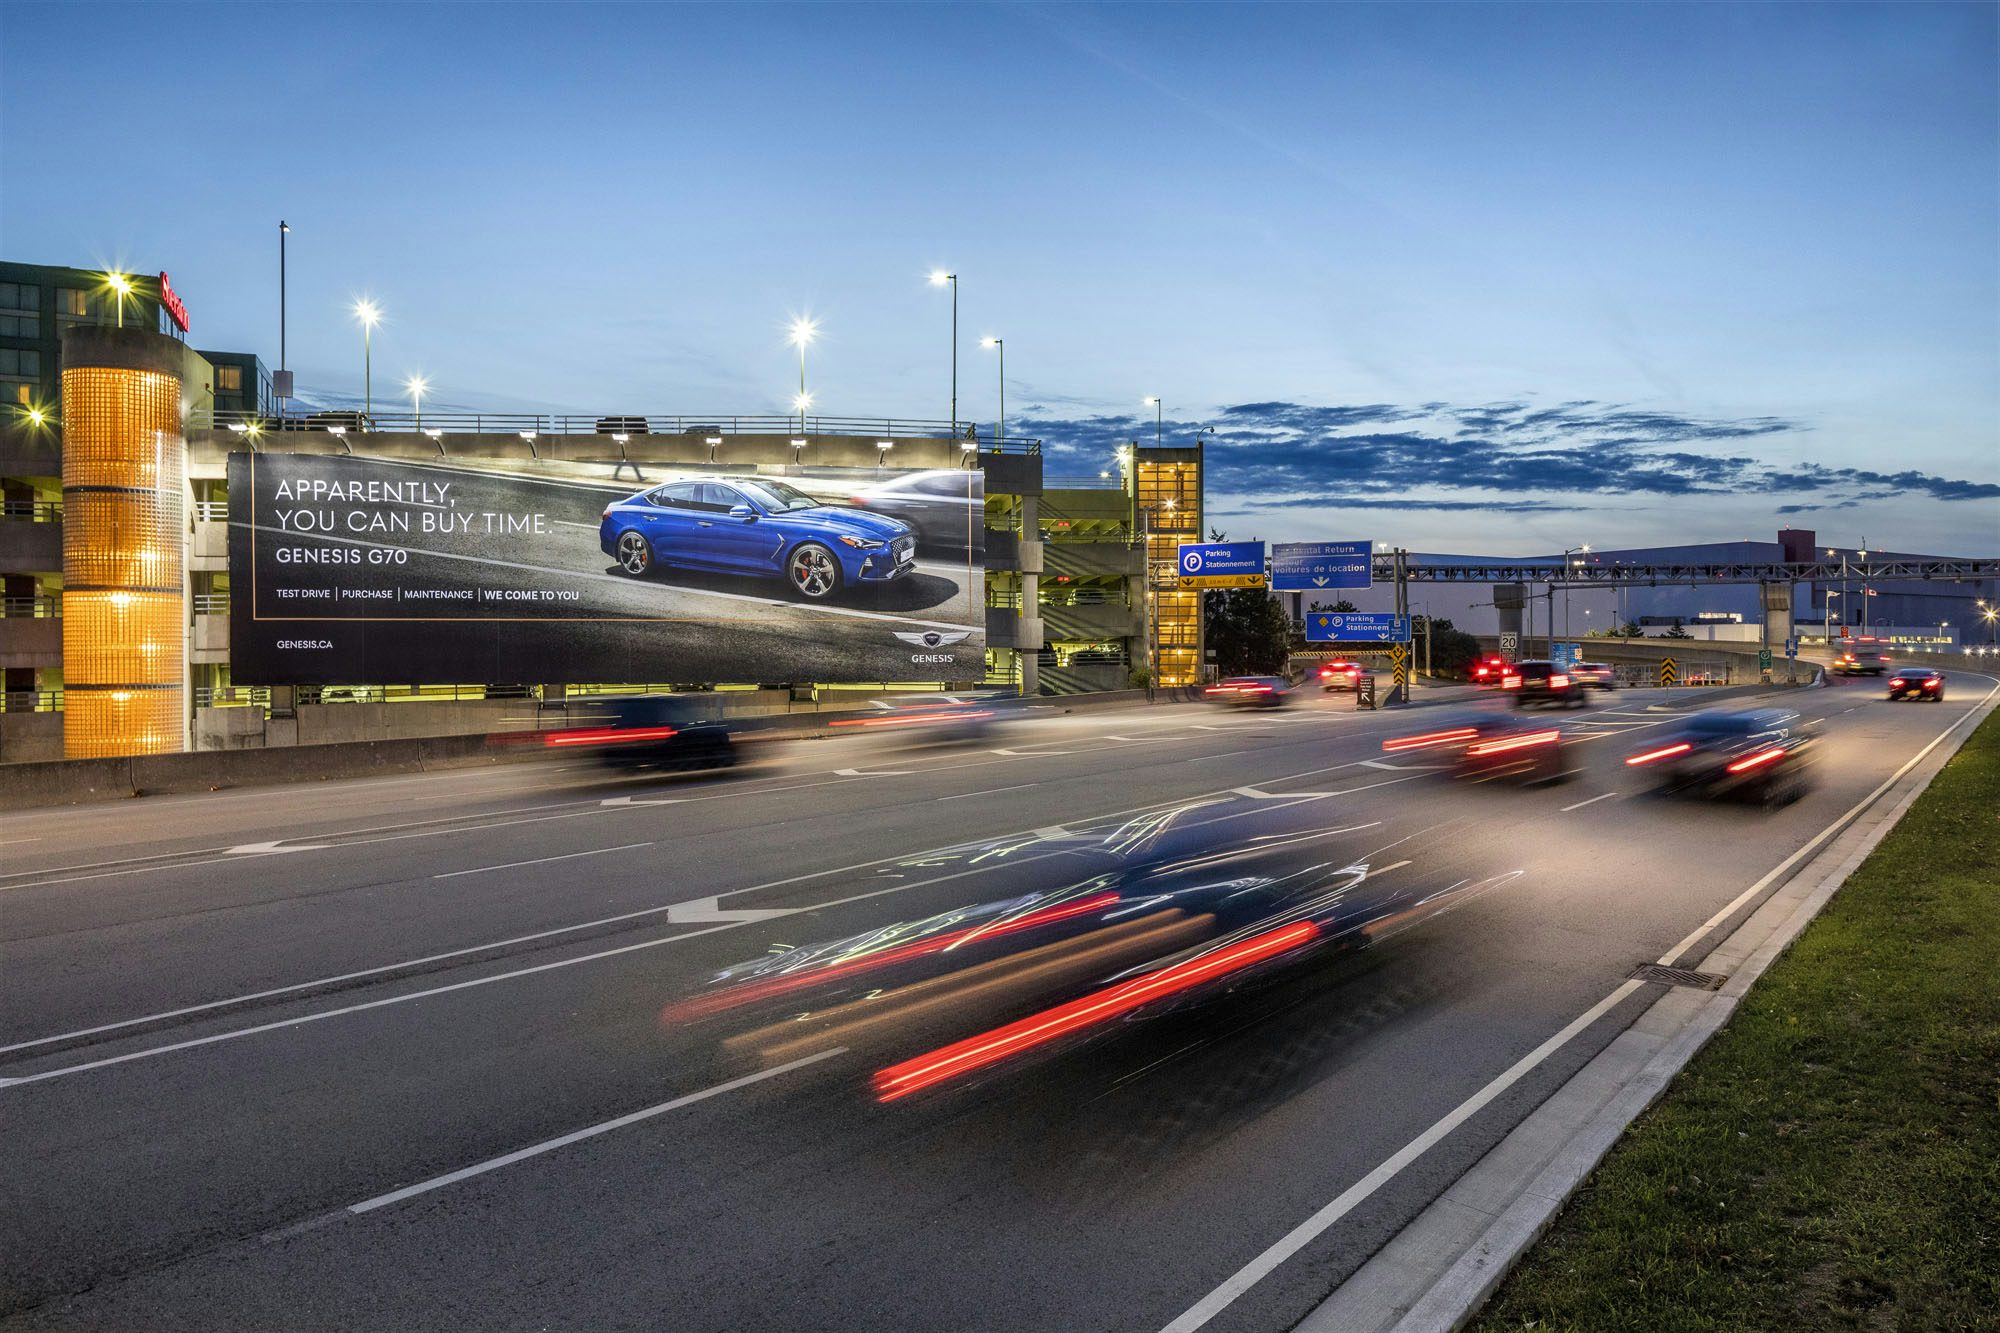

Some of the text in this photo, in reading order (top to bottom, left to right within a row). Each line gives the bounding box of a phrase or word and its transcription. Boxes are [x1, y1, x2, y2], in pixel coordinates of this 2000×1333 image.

[275, 479, 456, 507] APPARENTLY,
[275, 509, 554, 535] YOU CAN BUY TIME.
[1205, 550, 1231, 558] Parking
[1324, 545, 1355, 554] Return
[276, 547, 407, 565] GENESIS G70
[1205, 560, 1256, 569] Stationnement
[1275, 563, 1366, 574] voitures de location
[276, 589, 580, 601] TEST DRIVE PURCHASE MAINTENANCE WE COME TO YOU
[1345, 615, 1375, 624] Parking
[1346, 624, 1389, 632] Stationnem
[276, 640, 333, 650] GENESIS.CA
[1502, 637, 1516, 648] 20
[911, 654, 953, 663] GENESIS
